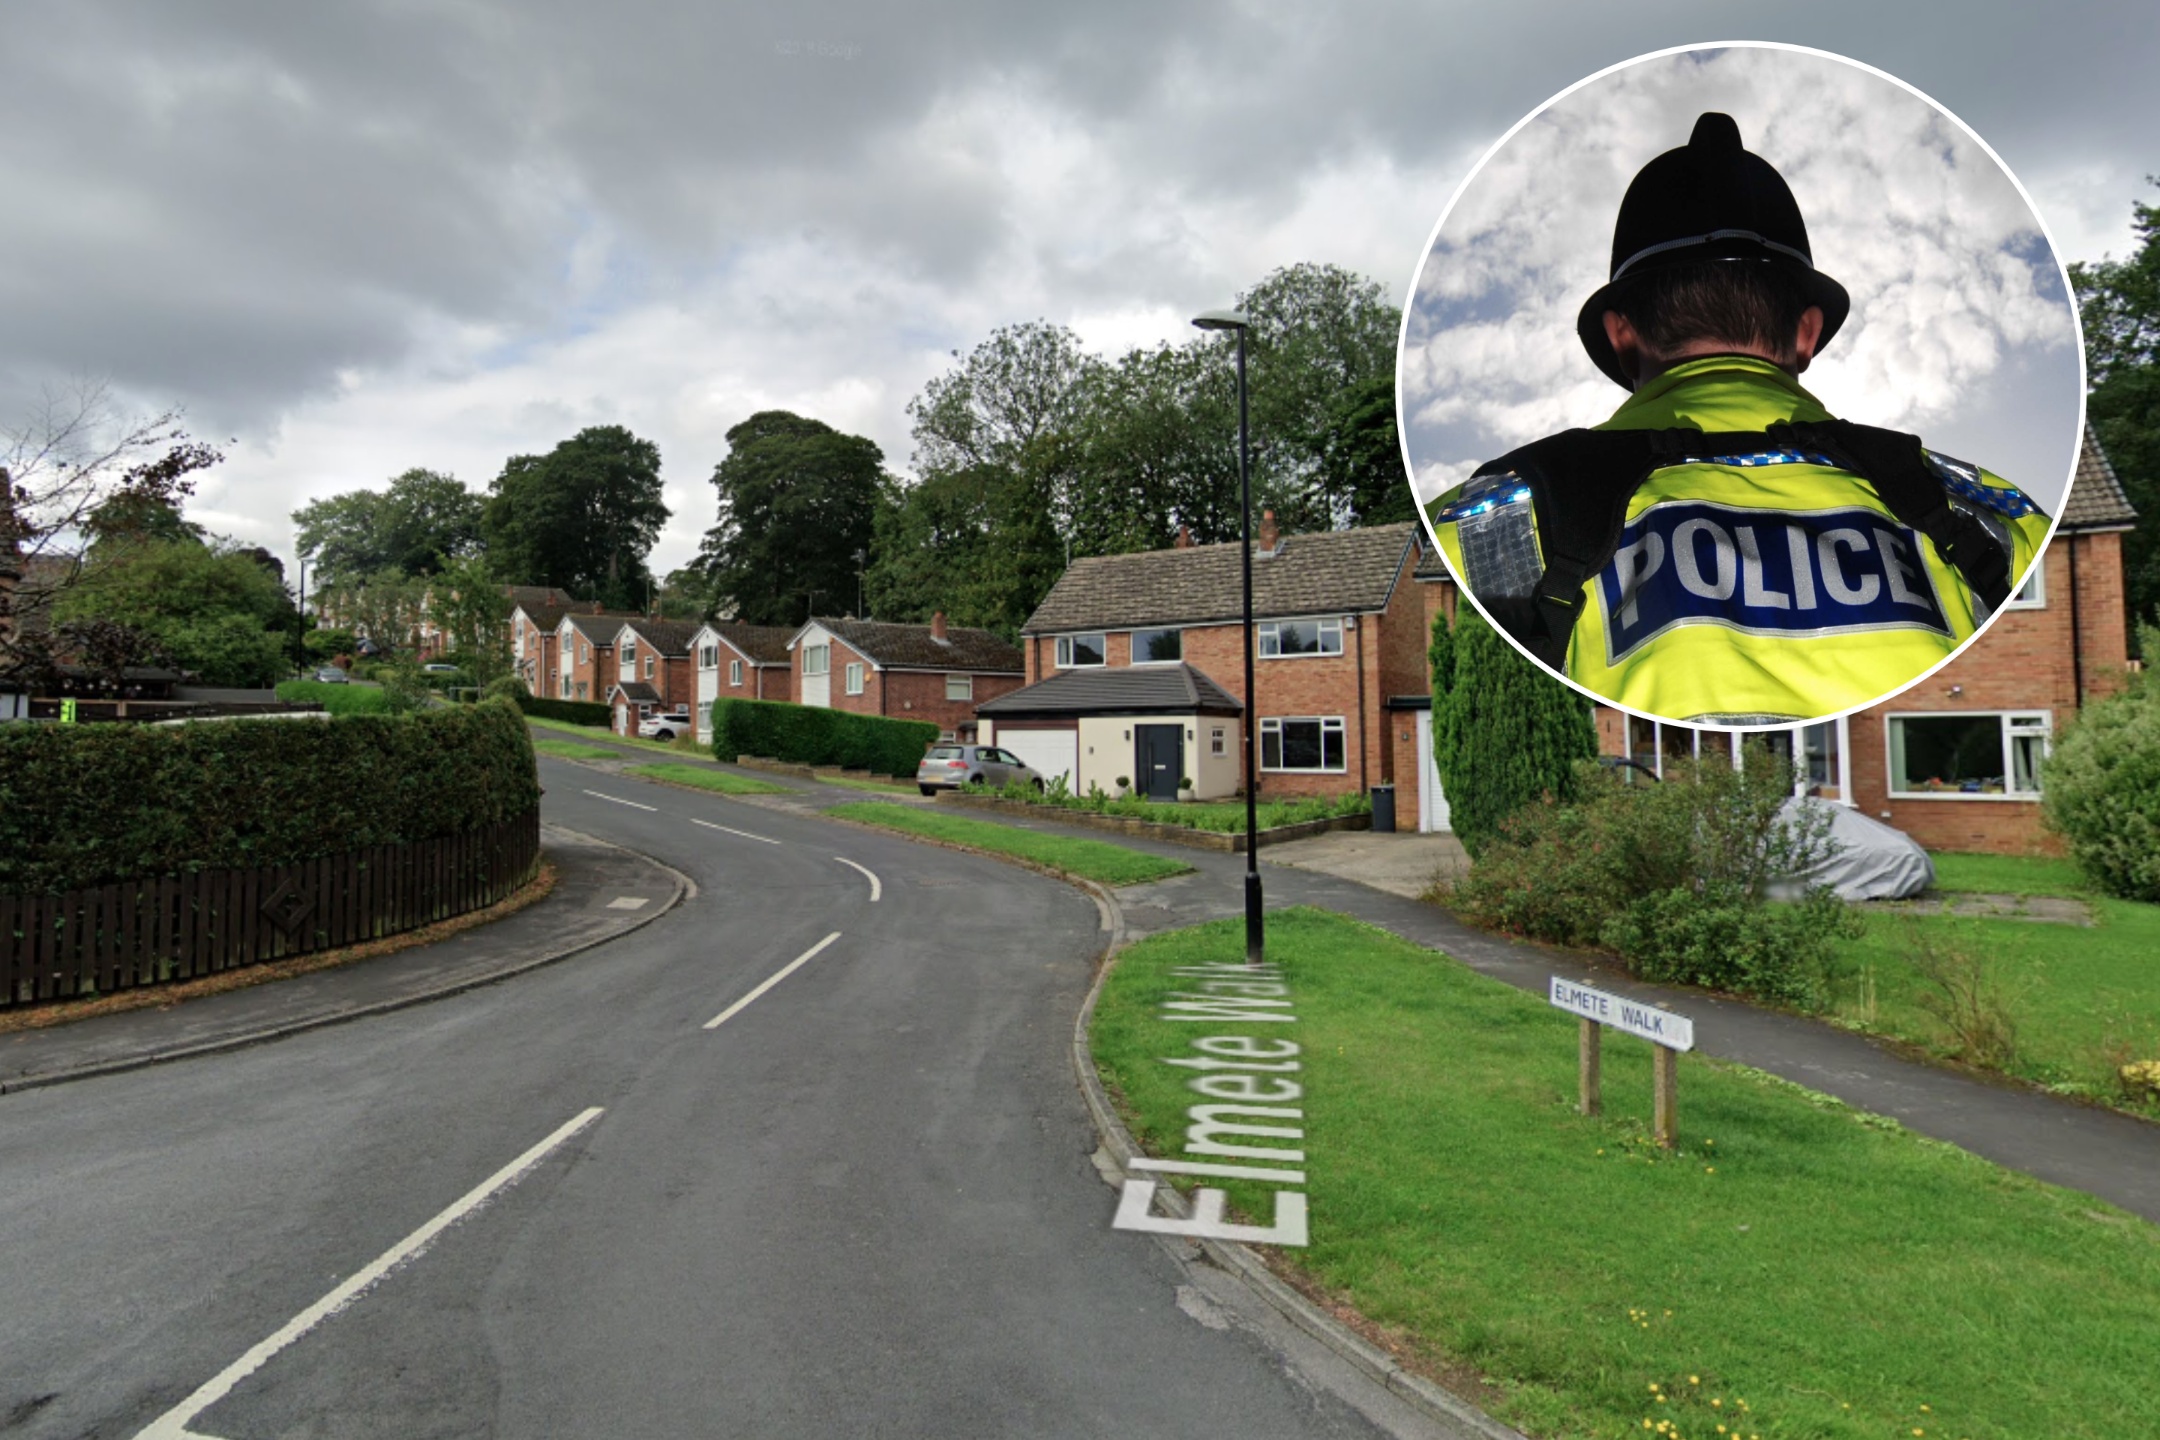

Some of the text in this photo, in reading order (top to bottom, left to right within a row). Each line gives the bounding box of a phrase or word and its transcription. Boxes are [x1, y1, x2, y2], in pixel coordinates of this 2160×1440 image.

[1614, 518, 1932, 631] POLICE
[1555, 983, 1608, 1016] ELMETE
[1622, 1005, 1664, 1036] WALK
